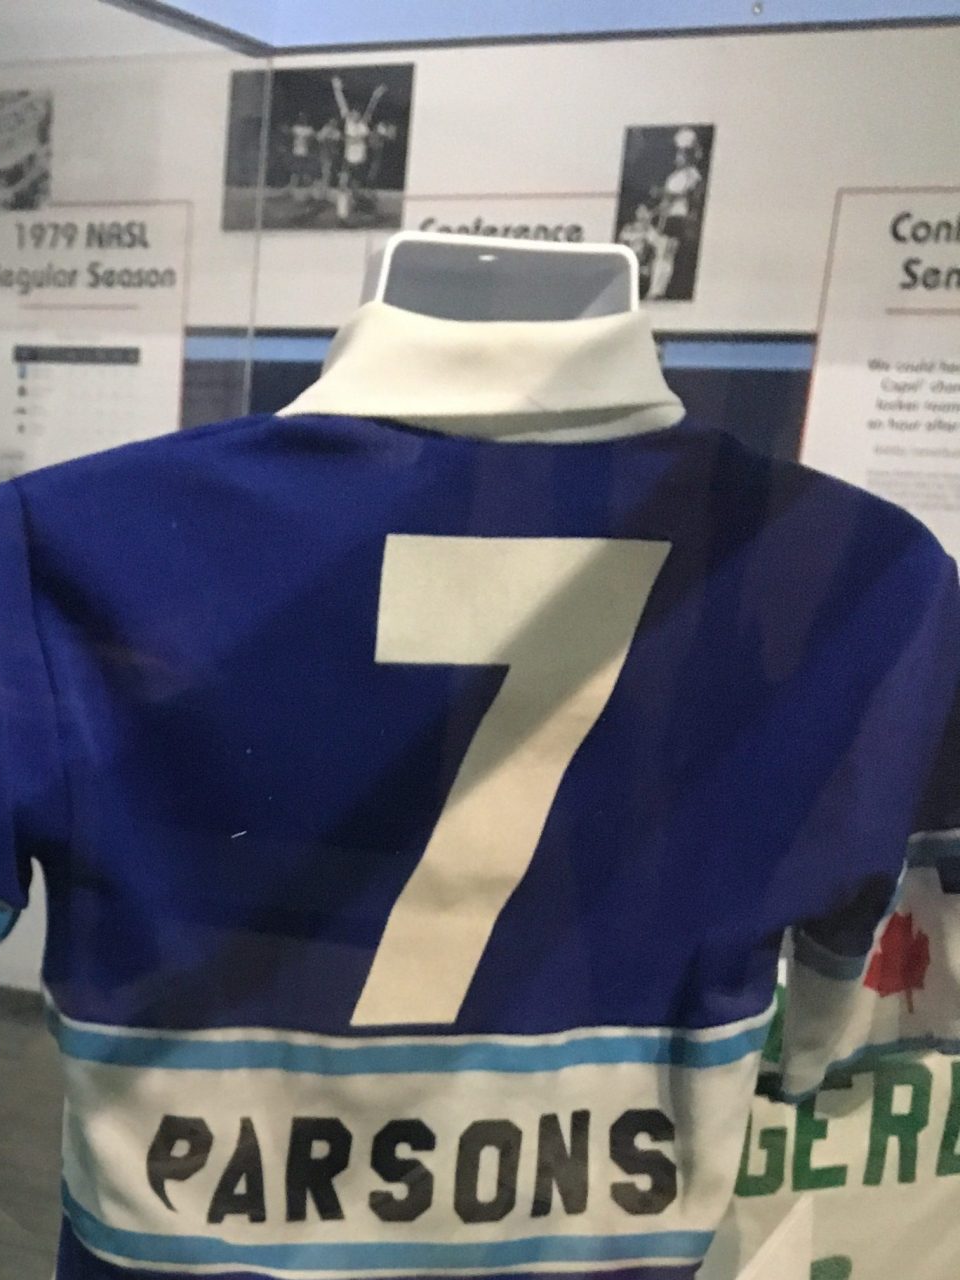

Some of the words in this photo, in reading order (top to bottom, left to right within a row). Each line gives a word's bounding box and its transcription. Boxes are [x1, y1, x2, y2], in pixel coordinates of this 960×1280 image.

[15, 221, 79, 249] 1979
[85, 221, 150, 249] NASL
[87, 261, 176, 288] Season
[350, 534, 672, 1027] 7
[146, 1108, 678, 1224] PARSONS
